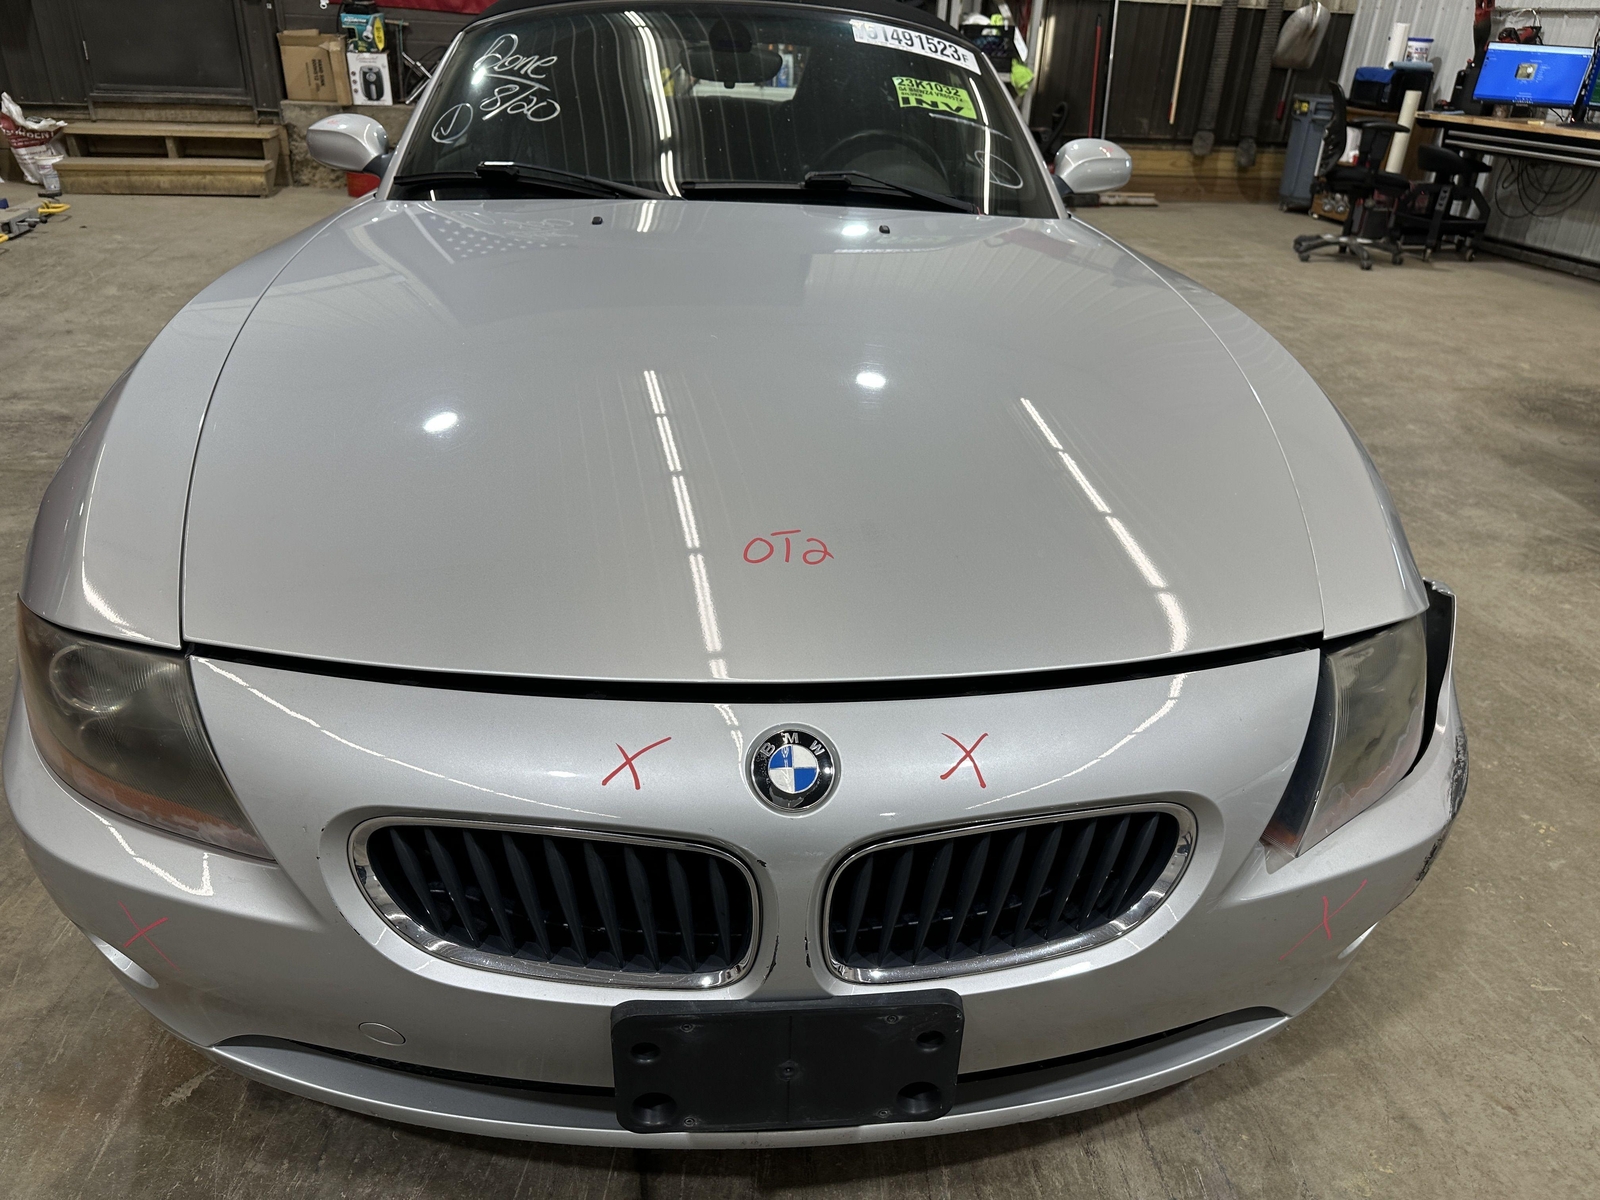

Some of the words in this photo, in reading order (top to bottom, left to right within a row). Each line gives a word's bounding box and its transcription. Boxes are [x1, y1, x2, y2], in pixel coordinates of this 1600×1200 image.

[472, 33, 558, 79] Done
[897, 77, 961, 98] 23K1032
[480, 84, 561, 121] 8/20
[901, 96, 964, 113] INV
[760, 732, 826, 757] BMW
